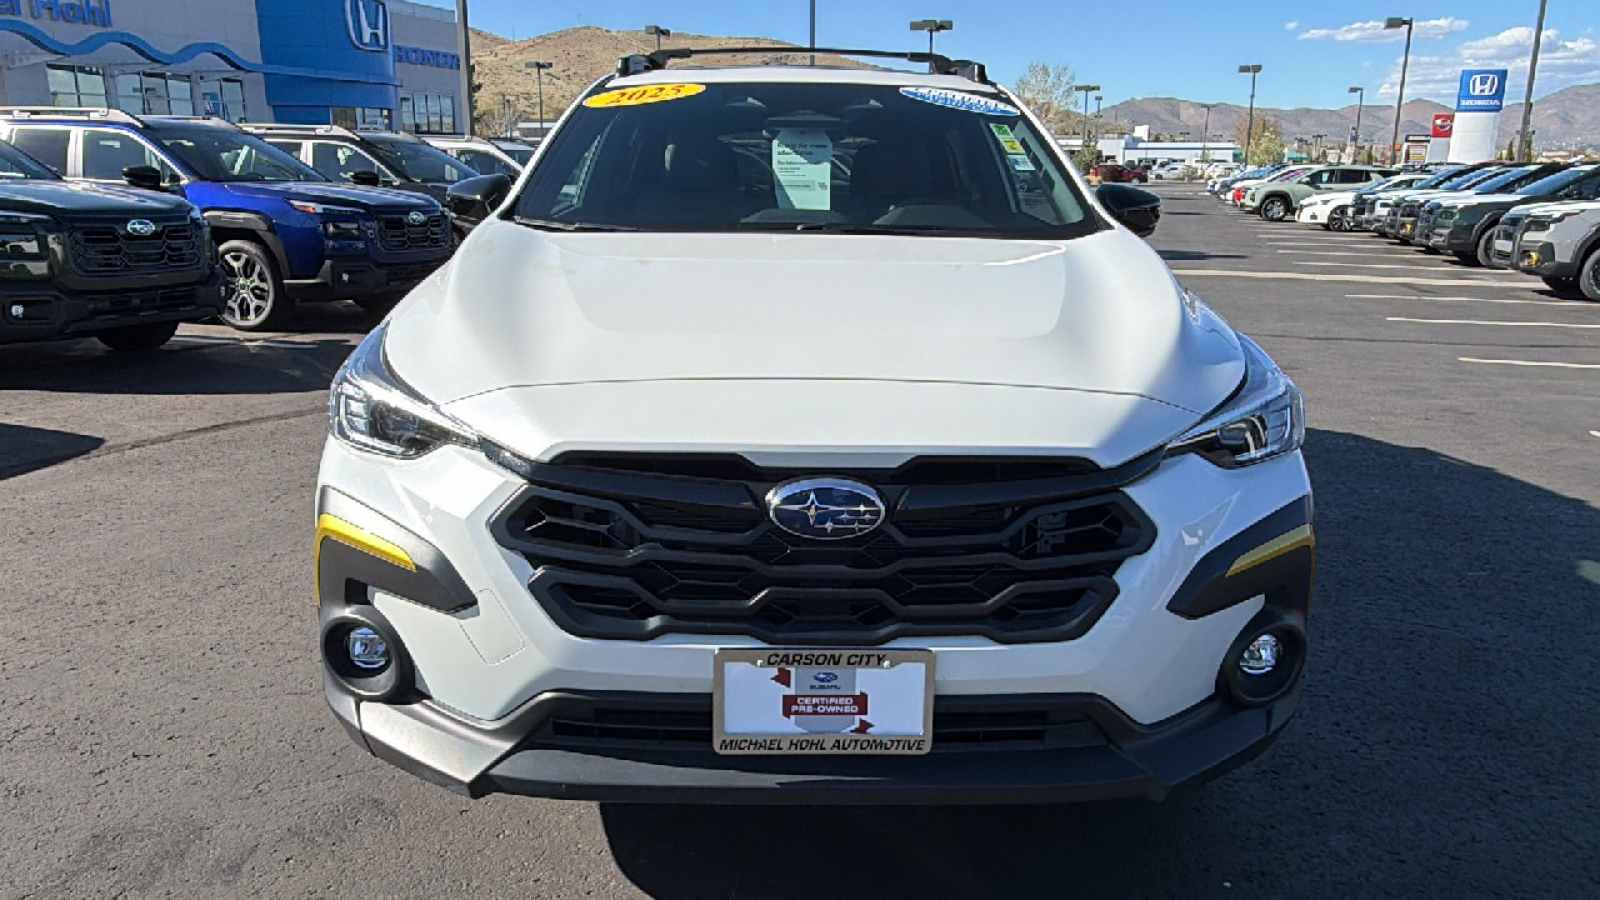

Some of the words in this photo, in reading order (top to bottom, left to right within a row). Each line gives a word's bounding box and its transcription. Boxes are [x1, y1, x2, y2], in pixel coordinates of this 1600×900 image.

[32, 0, 111, 27] Hohl
[607, 85, 685, 104] 2025
[767, 653, 841, 666] CARSON
[849, 653, 886, 666] CITY
[790, 705, 858, 713] PRE-OWNED
[720, 739, 784, 751] MICHAEL
[788, 739, 827, 751] HOHL
[832, 739, 926, 751] AUTOMOTIVE
